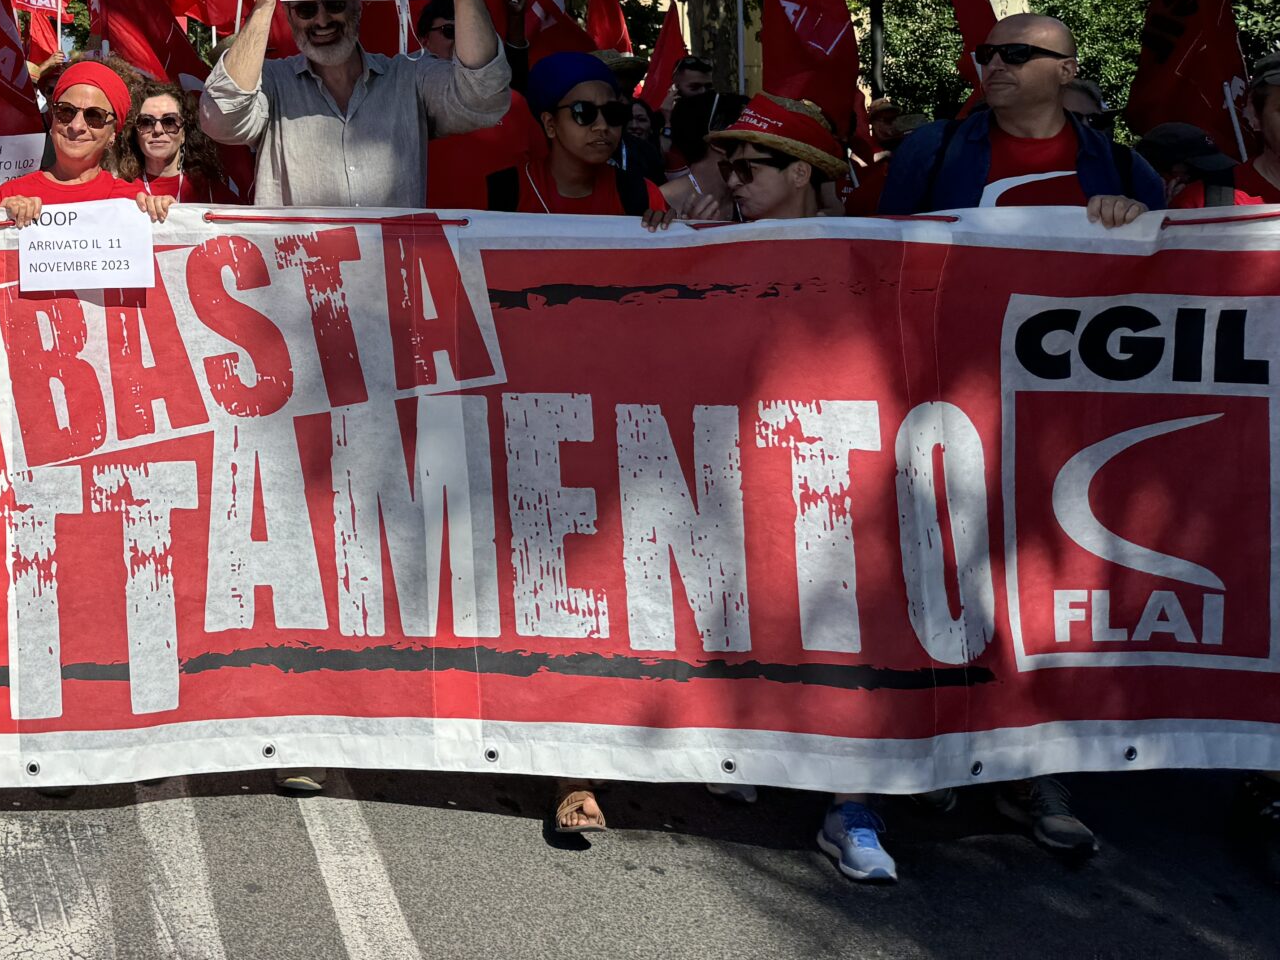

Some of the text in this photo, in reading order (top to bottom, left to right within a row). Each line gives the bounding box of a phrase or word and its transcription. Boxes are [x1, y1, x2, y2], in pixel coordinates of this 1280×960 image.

[28, 238, 122, 251] ARRIVATO IL 11
[29, 259, 130, 273] NOVEMBRE 2023
[1015, 305, 1269, 385] CGIL
[1054, 589, 1225, 645] FLAI
